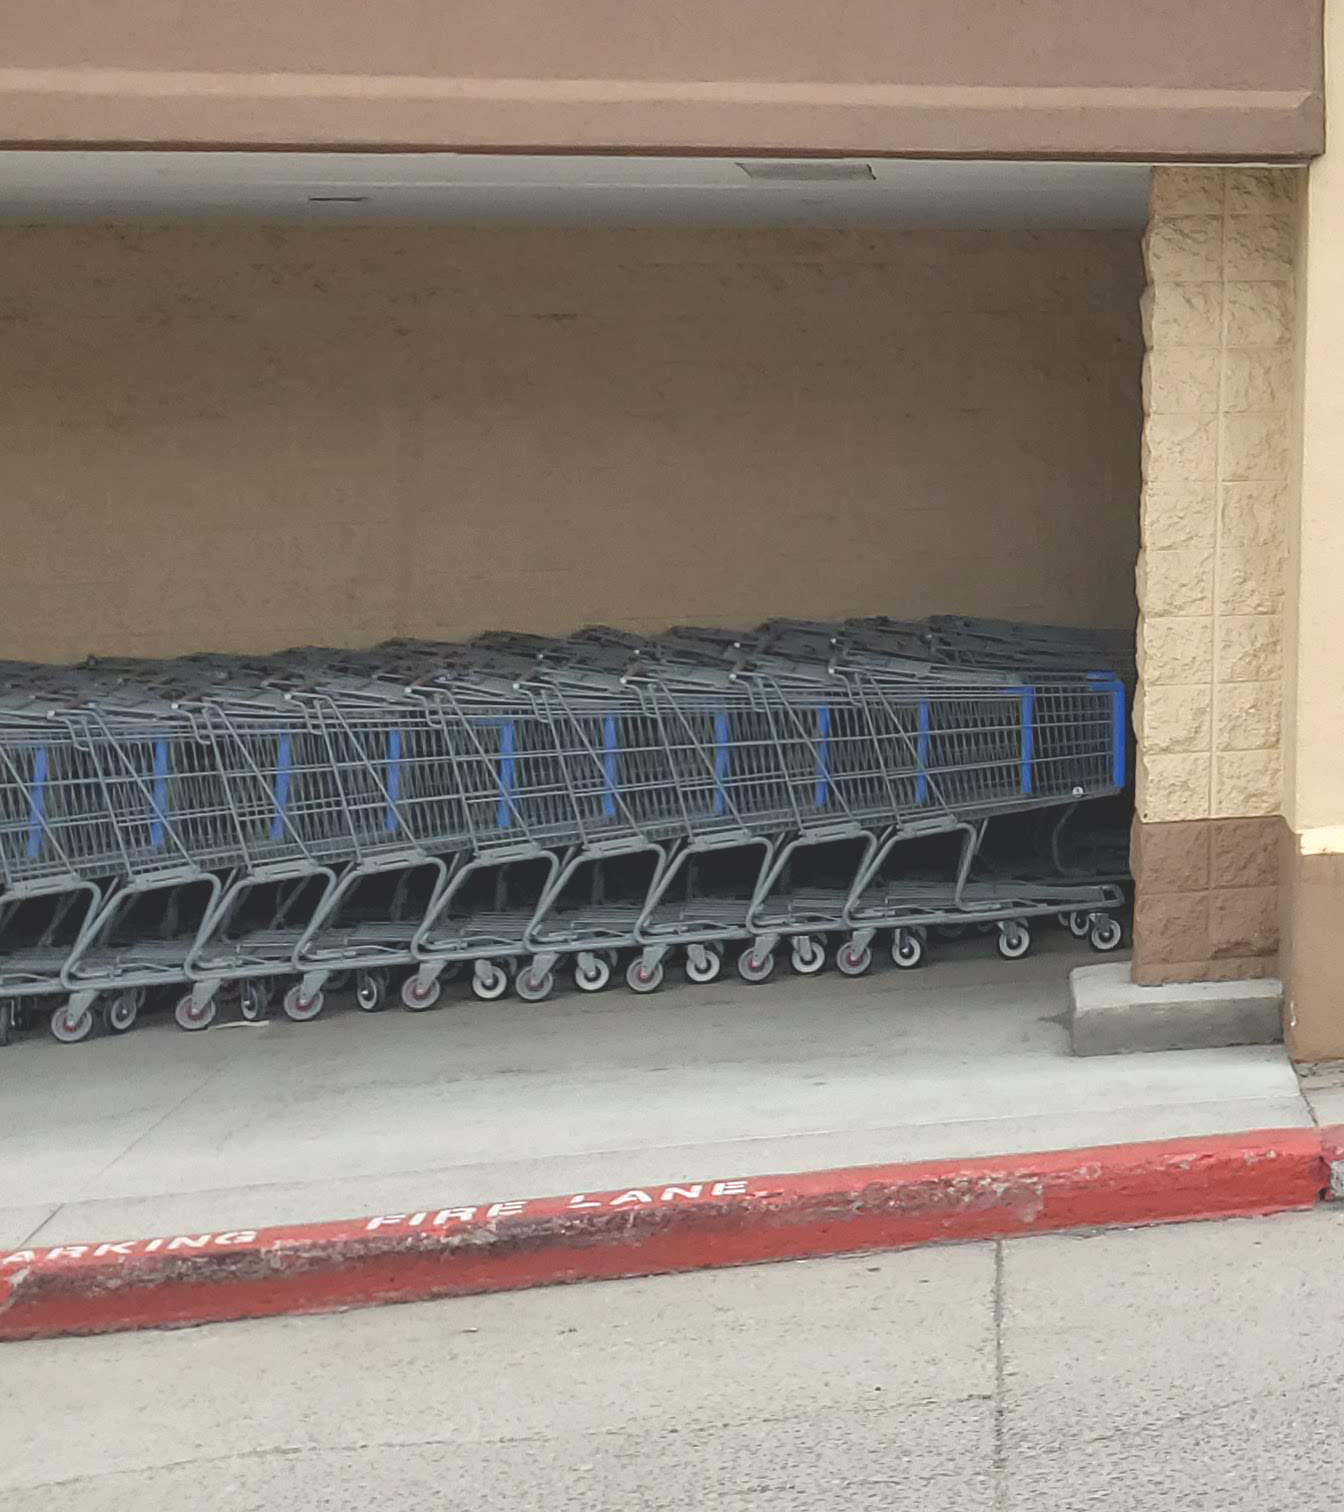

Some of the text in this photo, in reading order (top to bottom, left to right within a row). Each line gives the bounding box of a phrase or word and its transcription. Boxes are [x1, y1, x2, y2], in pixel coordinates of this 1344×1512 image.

[0, 1180, 749, 1266] ARKING FIRE LANE
